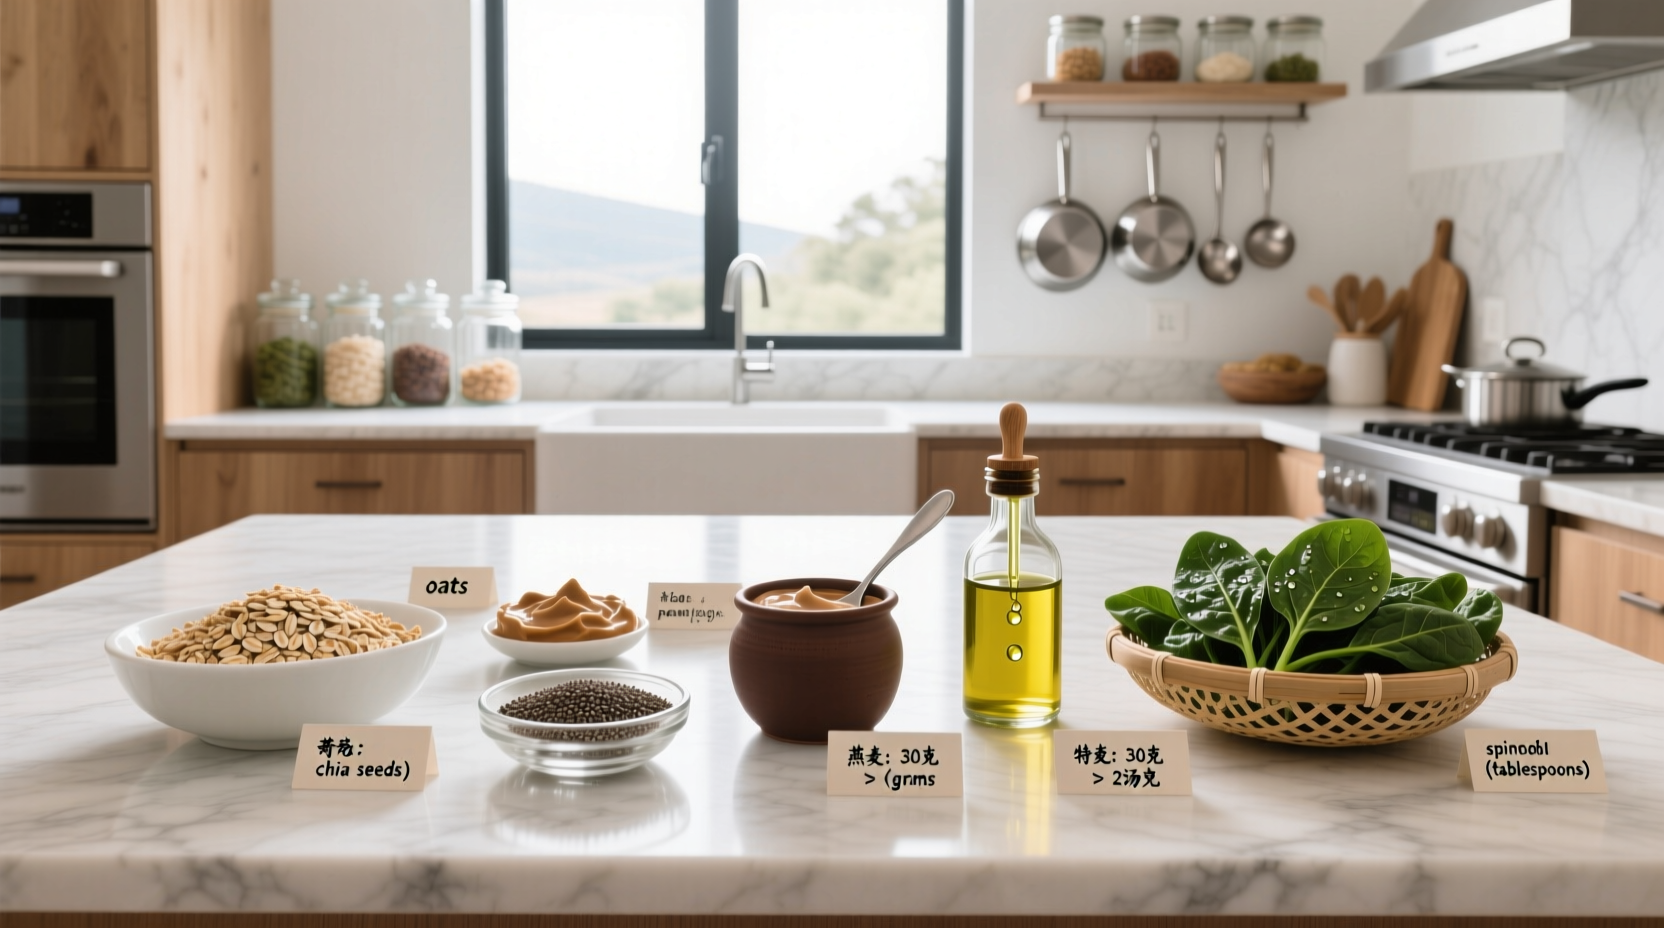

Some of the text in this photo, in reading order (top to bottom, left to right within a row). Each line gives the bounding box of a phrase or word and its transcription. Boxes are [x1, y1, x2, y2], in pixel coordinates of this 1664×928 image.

[424, 576, 469, 595] oats
[900, 743, 940, 767] 30克
[1125, 744, 1165, 766] 30克
[315, 759, 412, 782] chia seeds)
[1485, 759, 1590, 782] (tablespoons)
